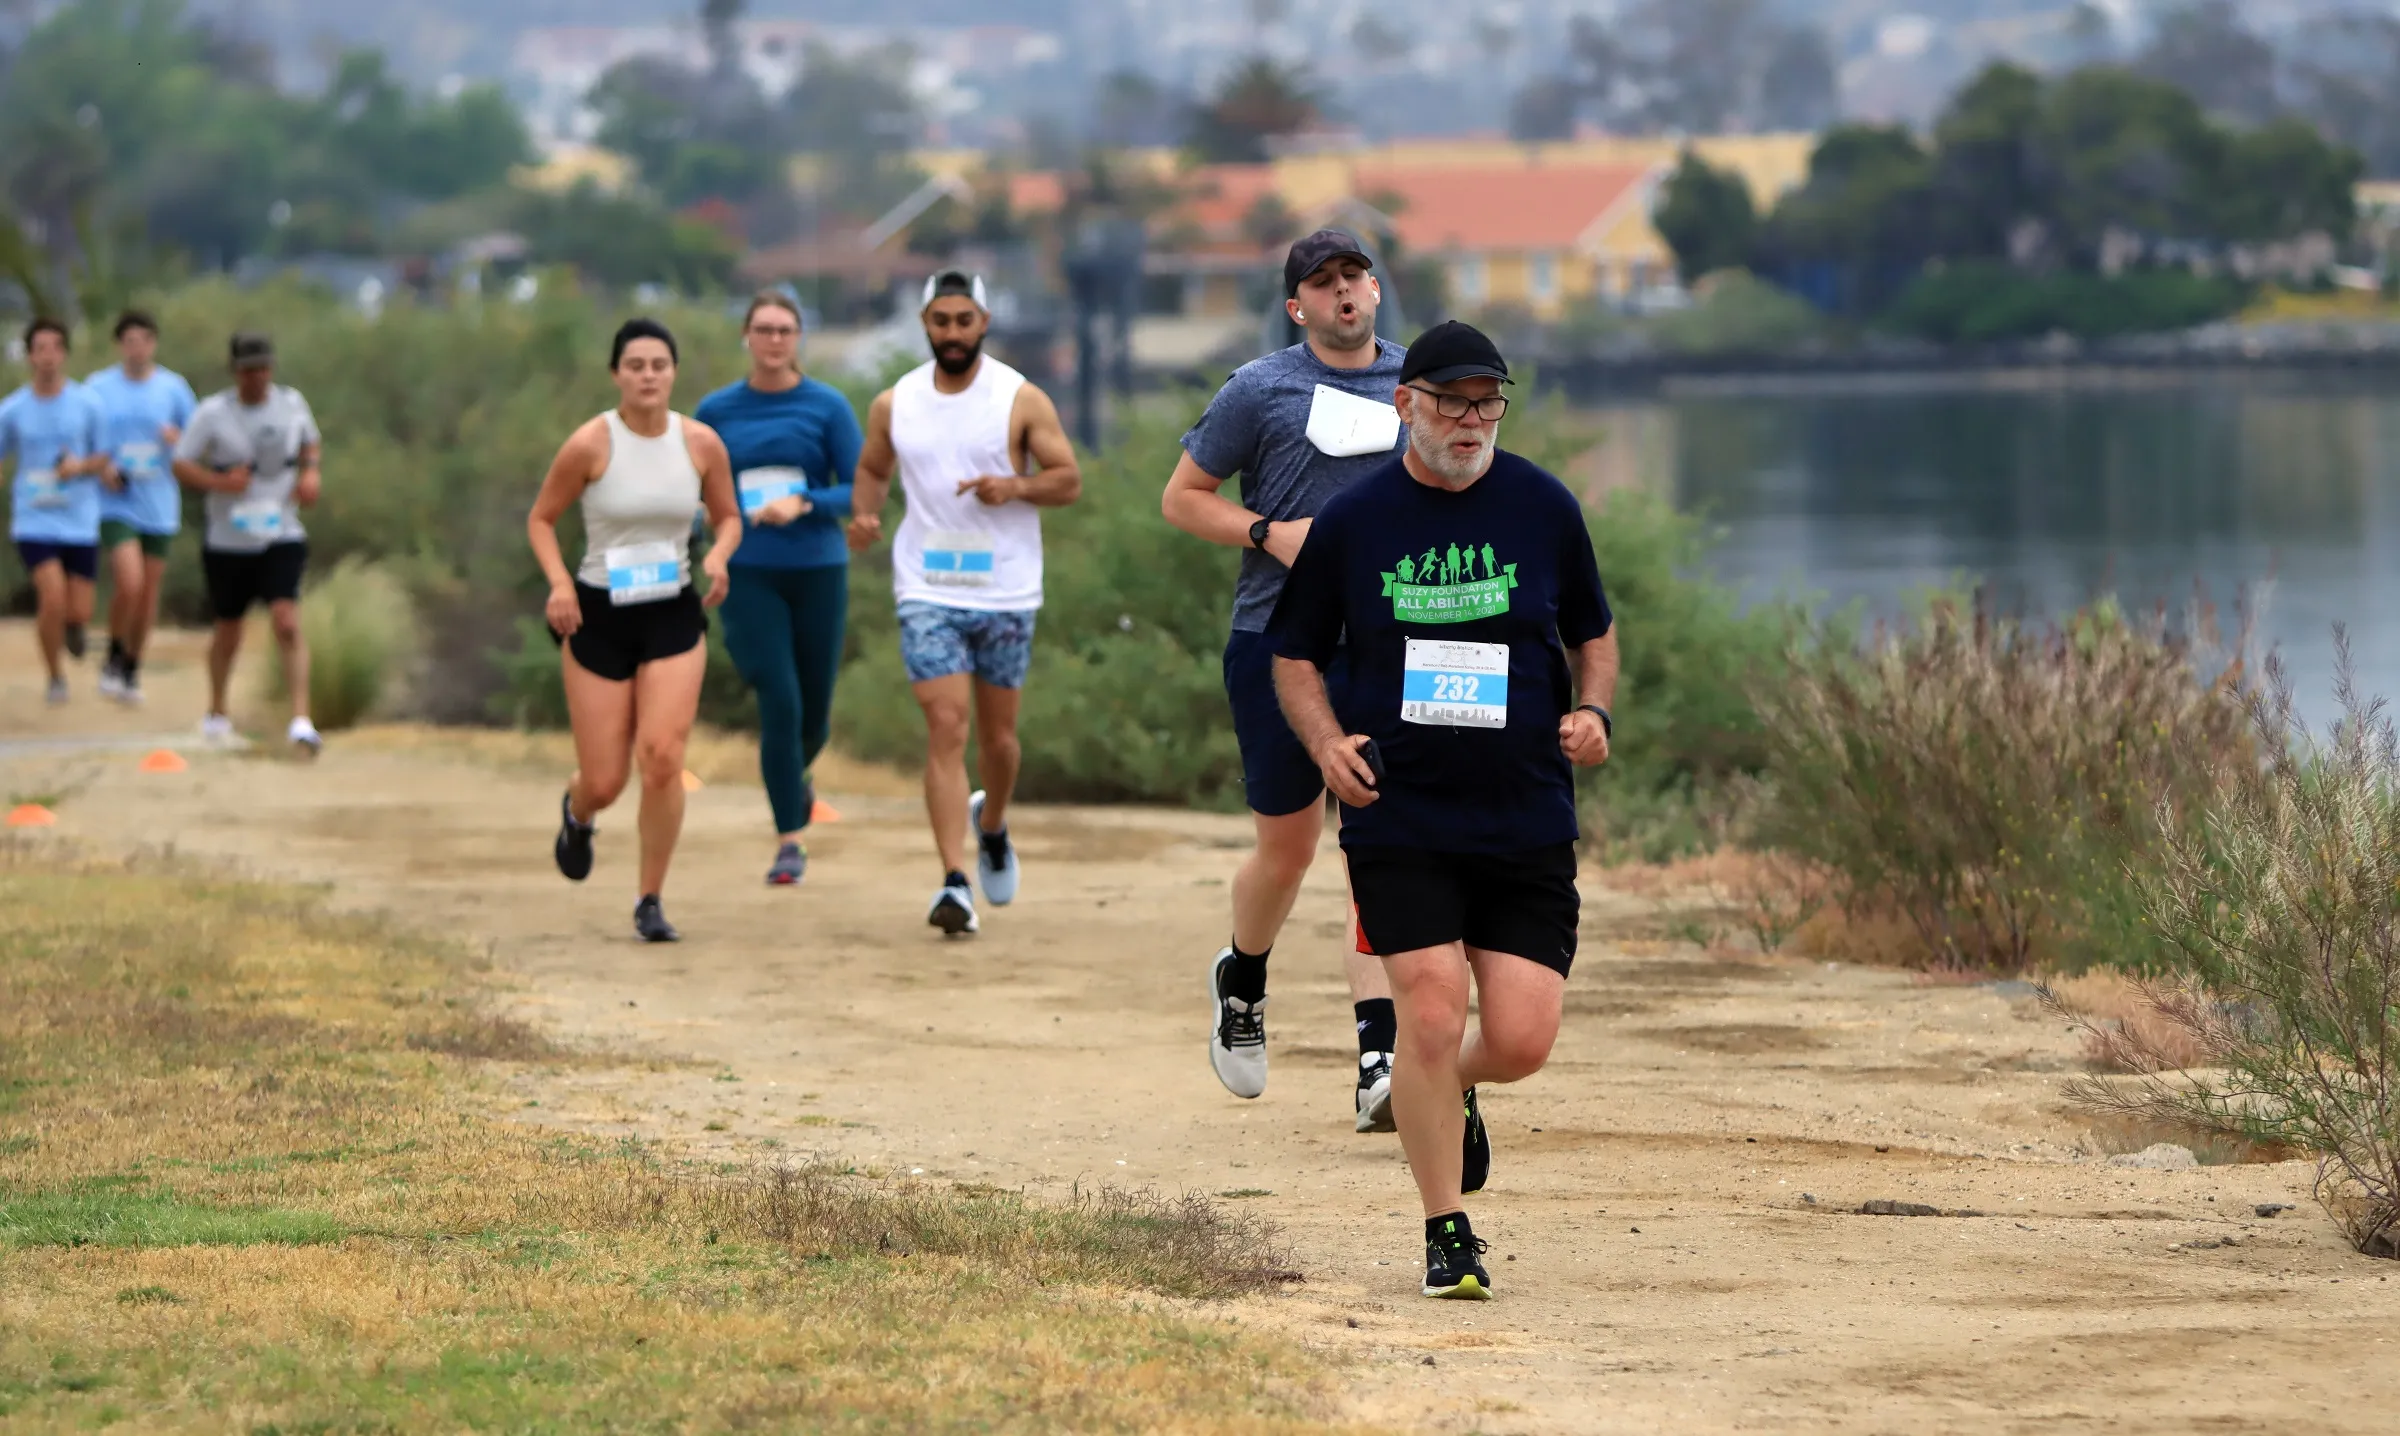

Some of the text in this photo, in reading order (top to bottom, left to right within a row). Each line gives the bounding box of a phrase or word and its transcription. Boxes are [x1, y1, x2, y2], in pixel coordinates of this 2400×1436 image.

[1402, 581, 1499, 596] SUZY FOUNDATION
[1397, 590, 1506, 609] ALL ABILITY 5 K
[1407, 610, 1462, 620] NOVEMBER
[1476, 604, 1496, 616] 2021
[1433, 674, 1479, 702] 232
